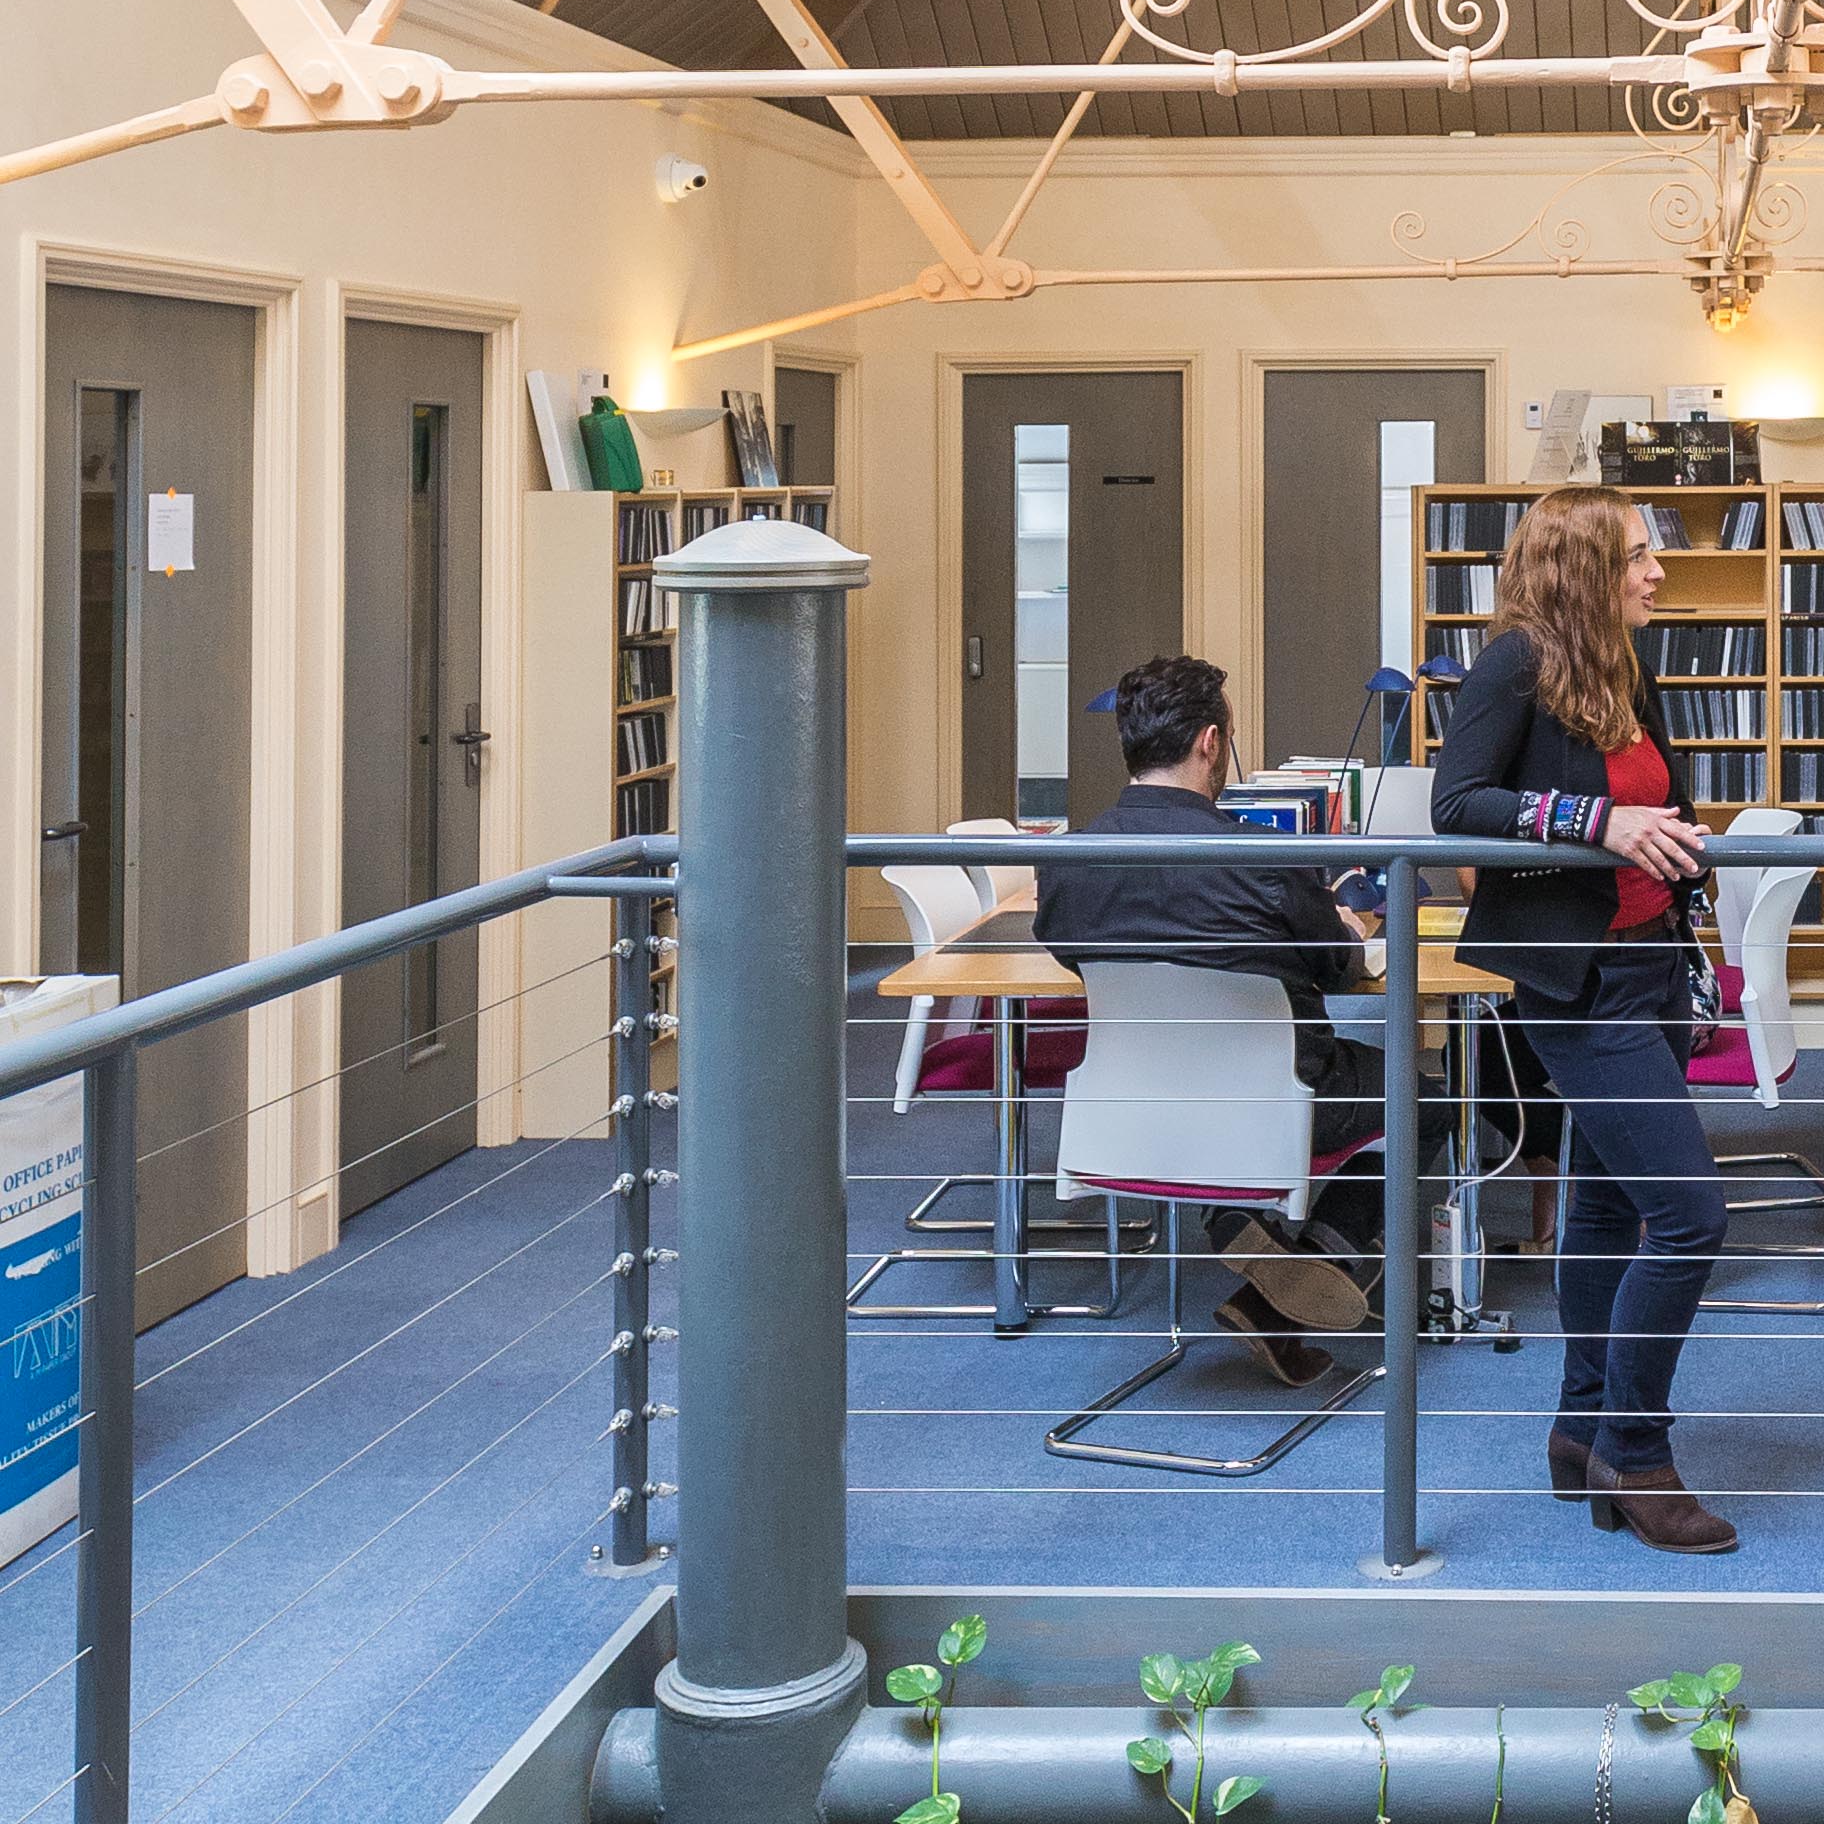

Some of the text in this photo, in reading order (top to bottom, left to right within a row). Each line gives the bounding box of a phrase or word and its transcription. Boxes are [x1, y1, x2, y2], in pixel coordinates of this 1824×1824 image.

[1626, 445, 1675, 456] GUILLERMO
[1682, 446, 1730, 456] GUILLERMO
[1633, 454, 1657, 462] TORO
[1688, 454, 1712, 462] TORO
[3, 1158, 53, 1194] OFFICE
